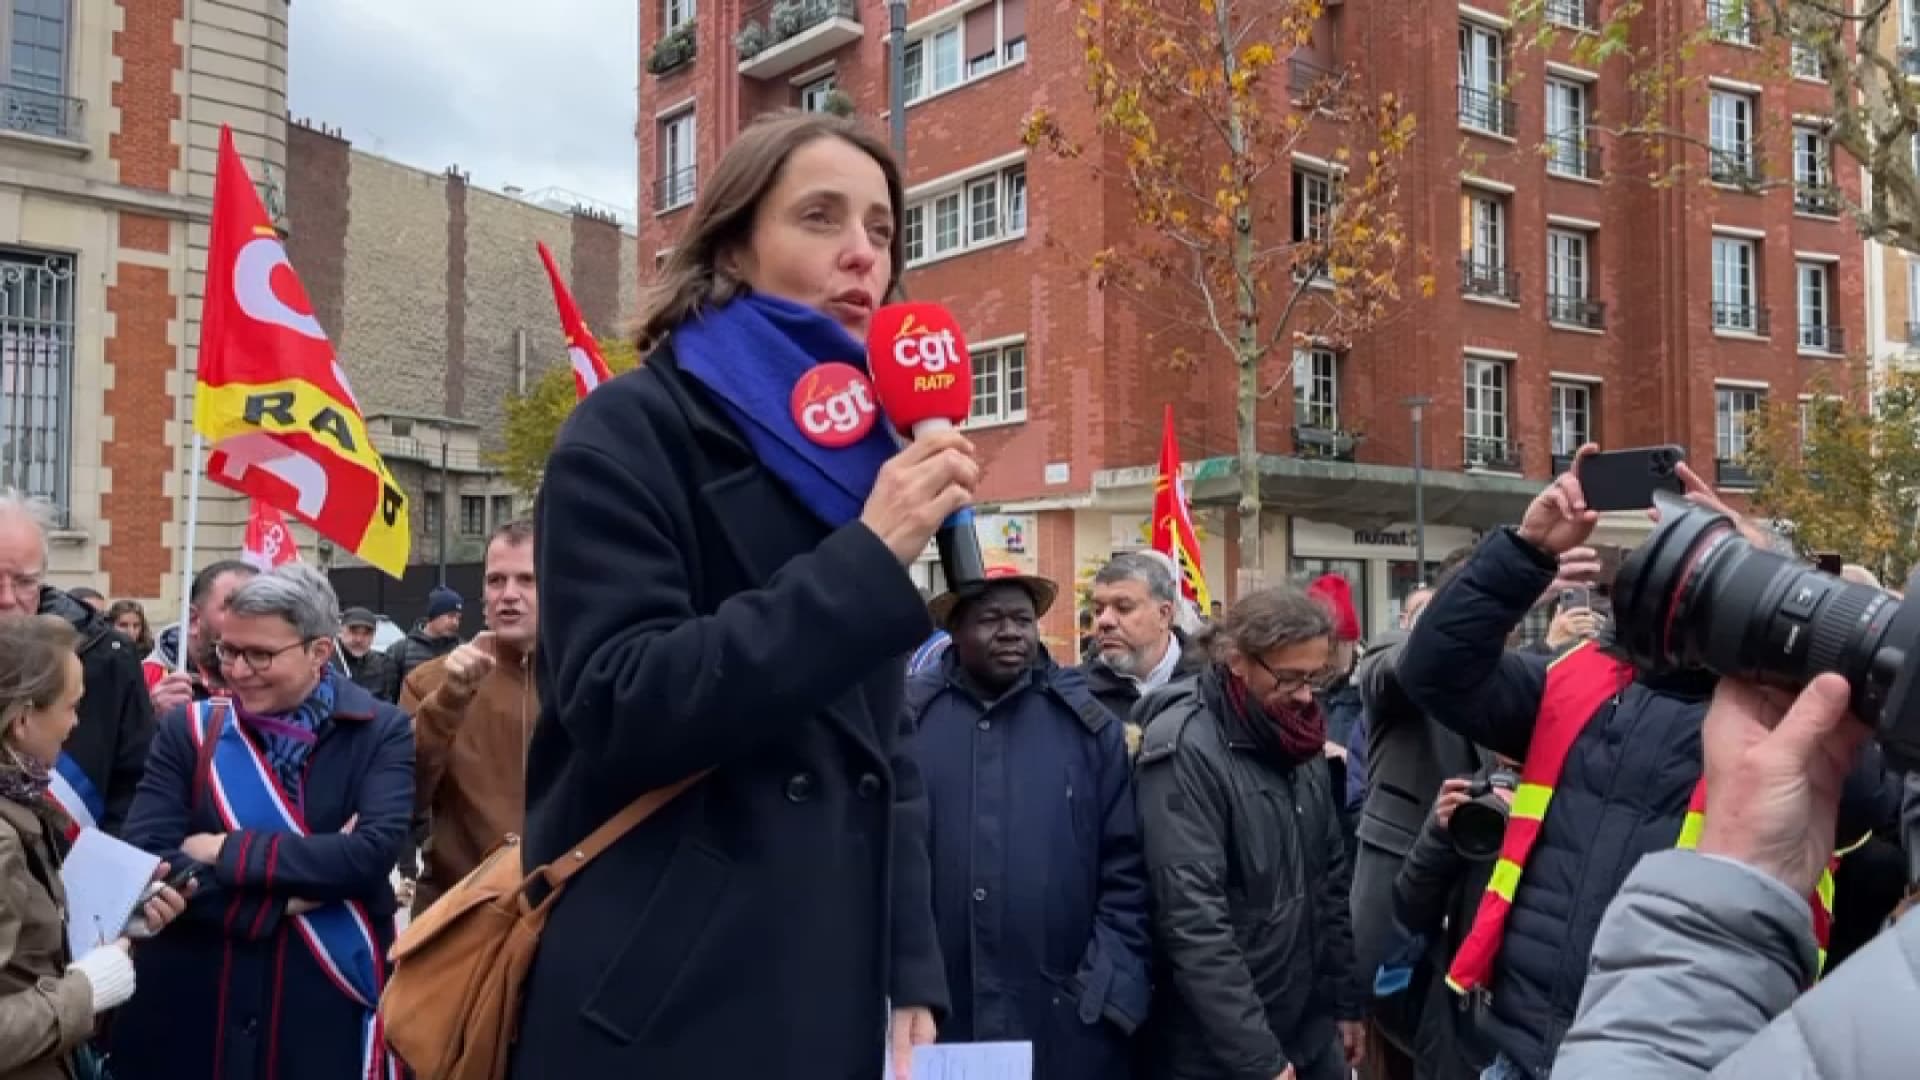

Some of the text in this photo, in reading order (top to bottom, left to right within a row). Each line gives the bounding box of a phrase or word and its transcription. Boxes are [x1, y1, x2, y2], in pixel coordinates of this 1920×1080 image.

[894, 329, 960, 373] cgt
[914, 374, 955, 392] RATP
[802, 379, 876, 434] cgt
